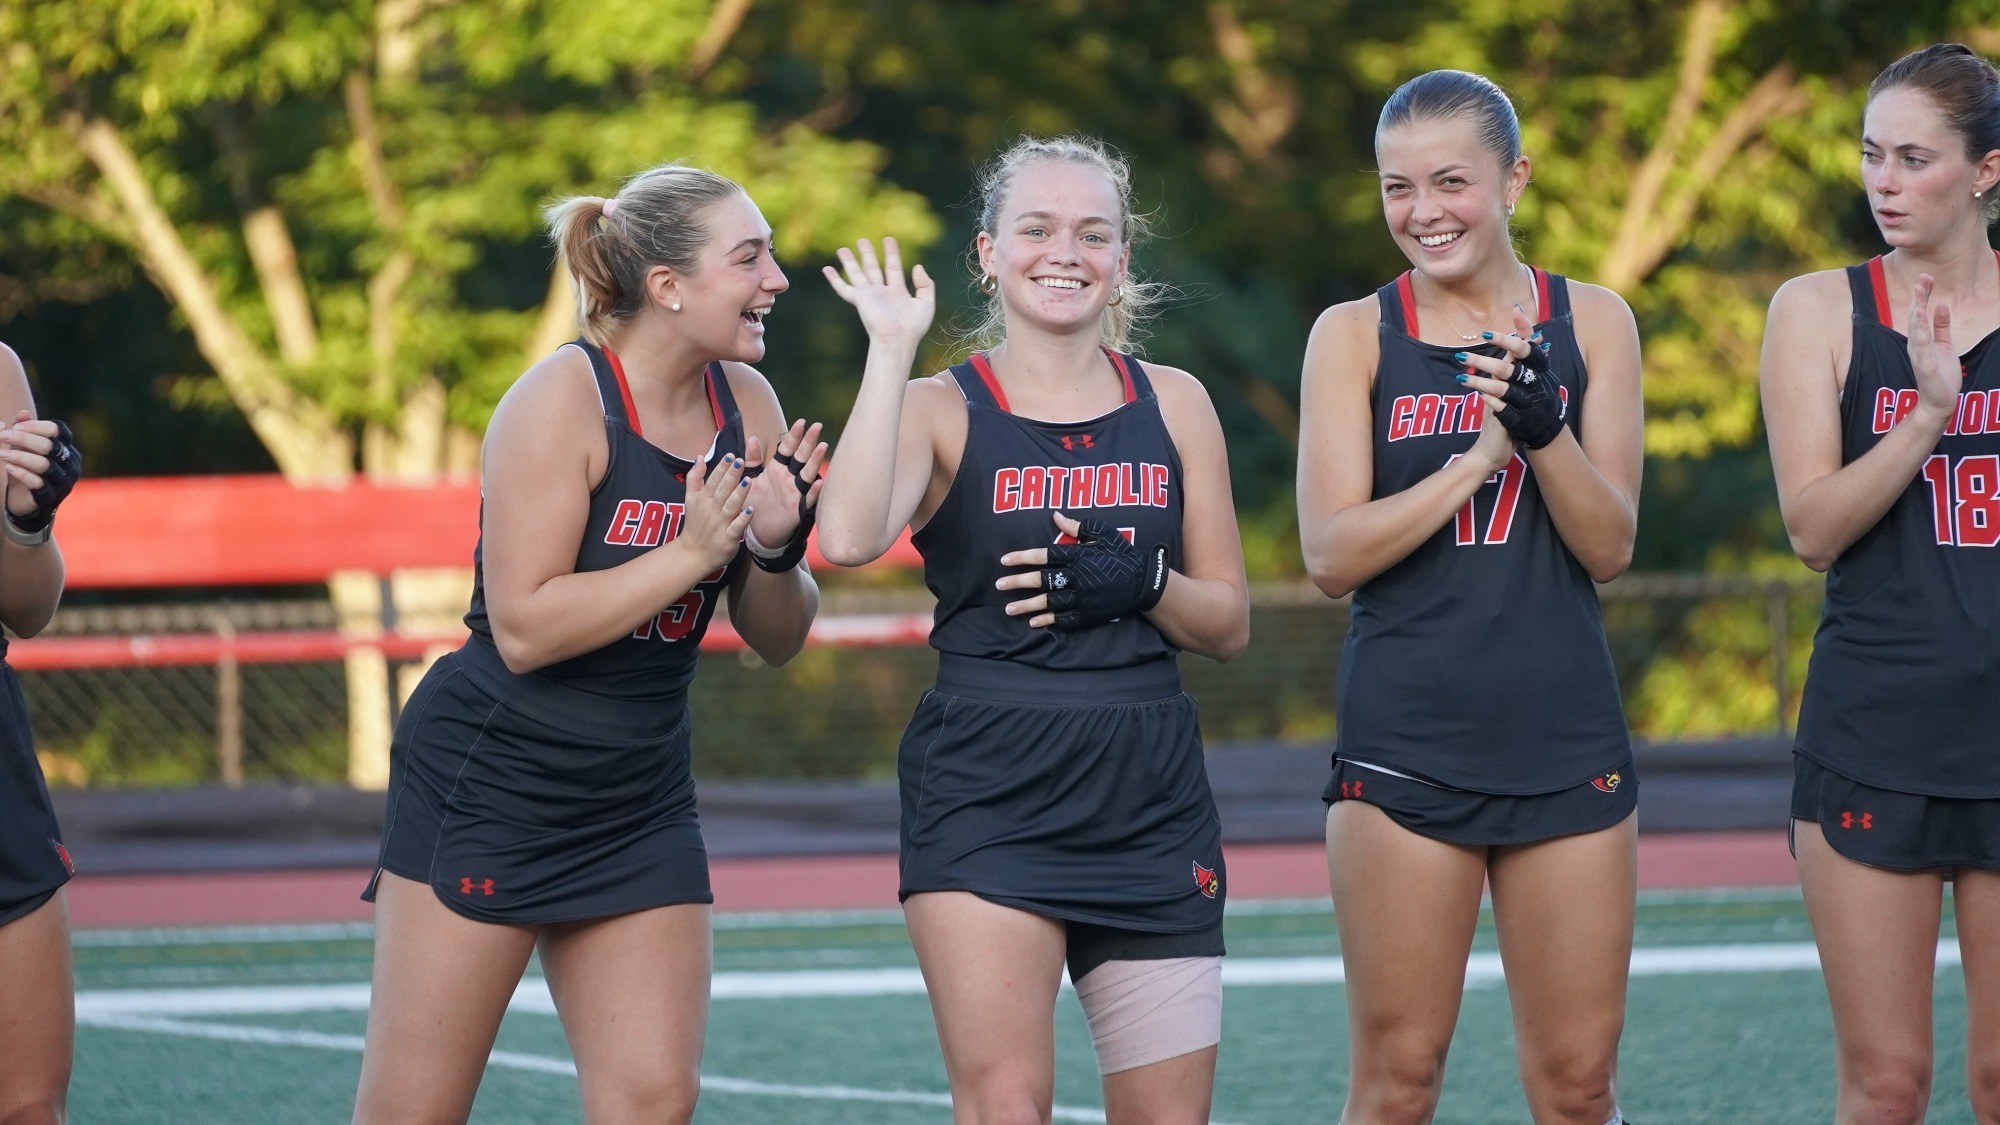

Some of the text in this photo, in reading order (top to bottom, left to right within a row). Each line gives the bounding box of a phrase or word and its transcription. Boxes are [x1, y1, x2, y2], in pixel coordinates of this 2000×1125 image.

[992, 462, 1169, 514] CATHOLIC
[1922, 454, 2000, 548] 18
[633, 565, 728, 643] 5
